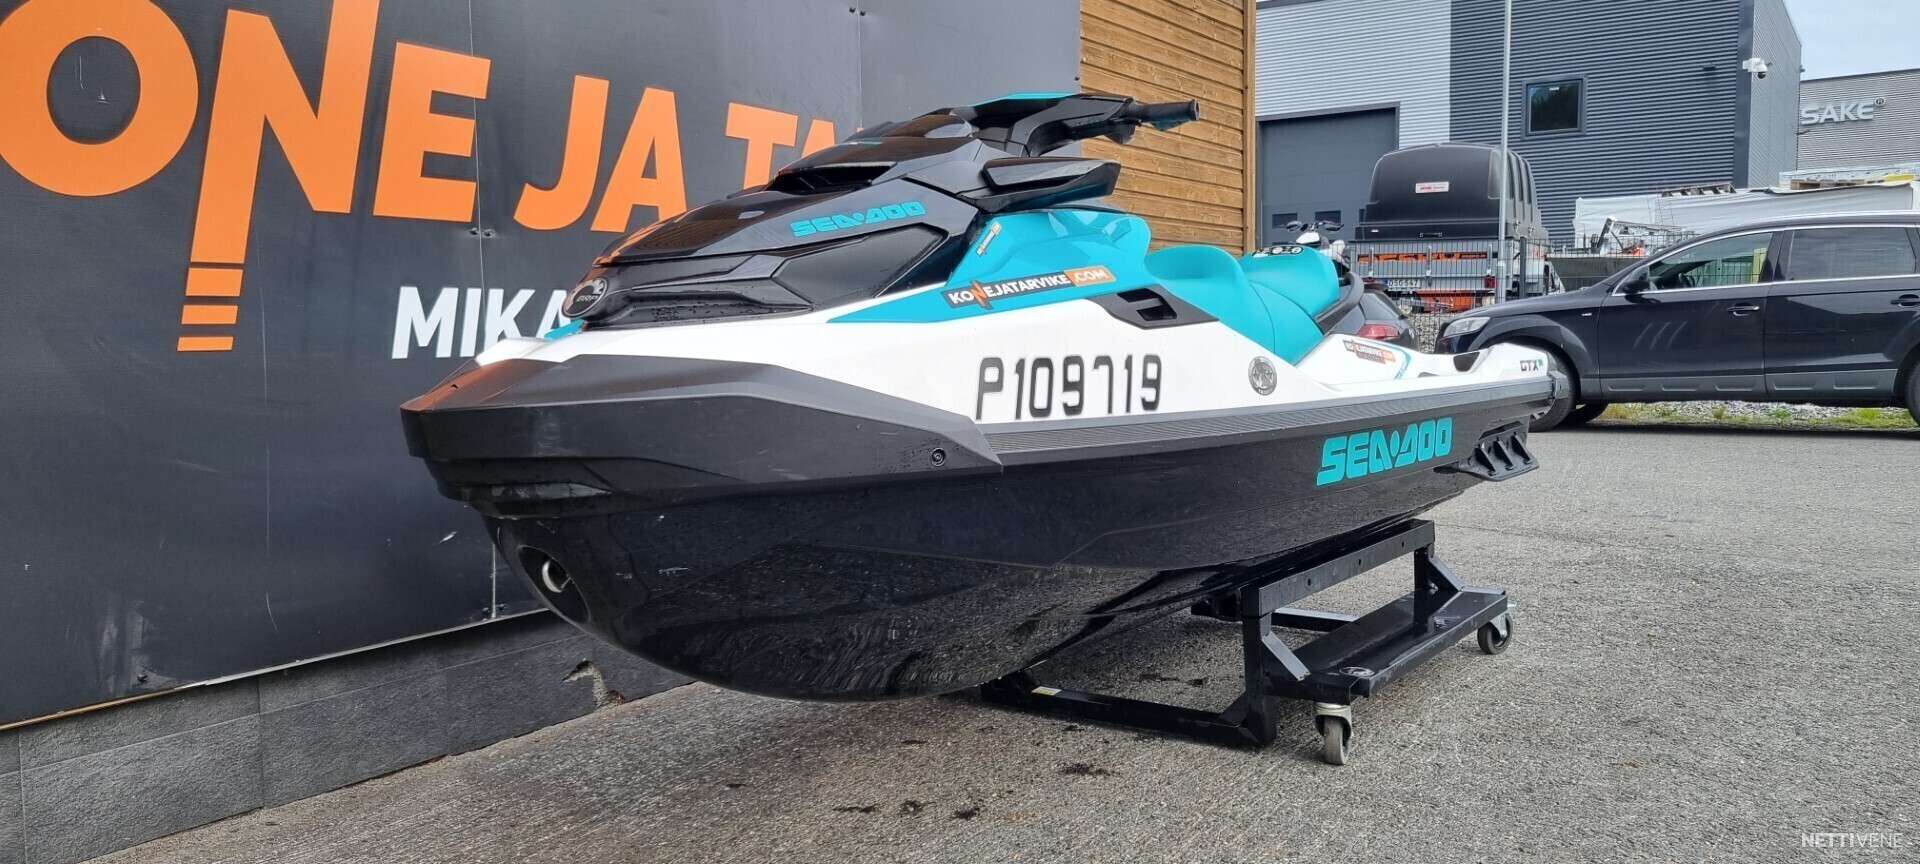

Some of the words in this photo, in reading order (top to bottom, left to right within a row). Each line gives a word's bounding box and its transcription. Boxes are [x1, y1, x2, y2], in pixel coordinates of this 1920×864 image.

[513, 75, 688, 232] JA
[948, 269, 1109, 307] KONEJATARVIKE.COM
[976, 354, 1162, 421] P109719
[1520, 359, 1539, 371] GTX
